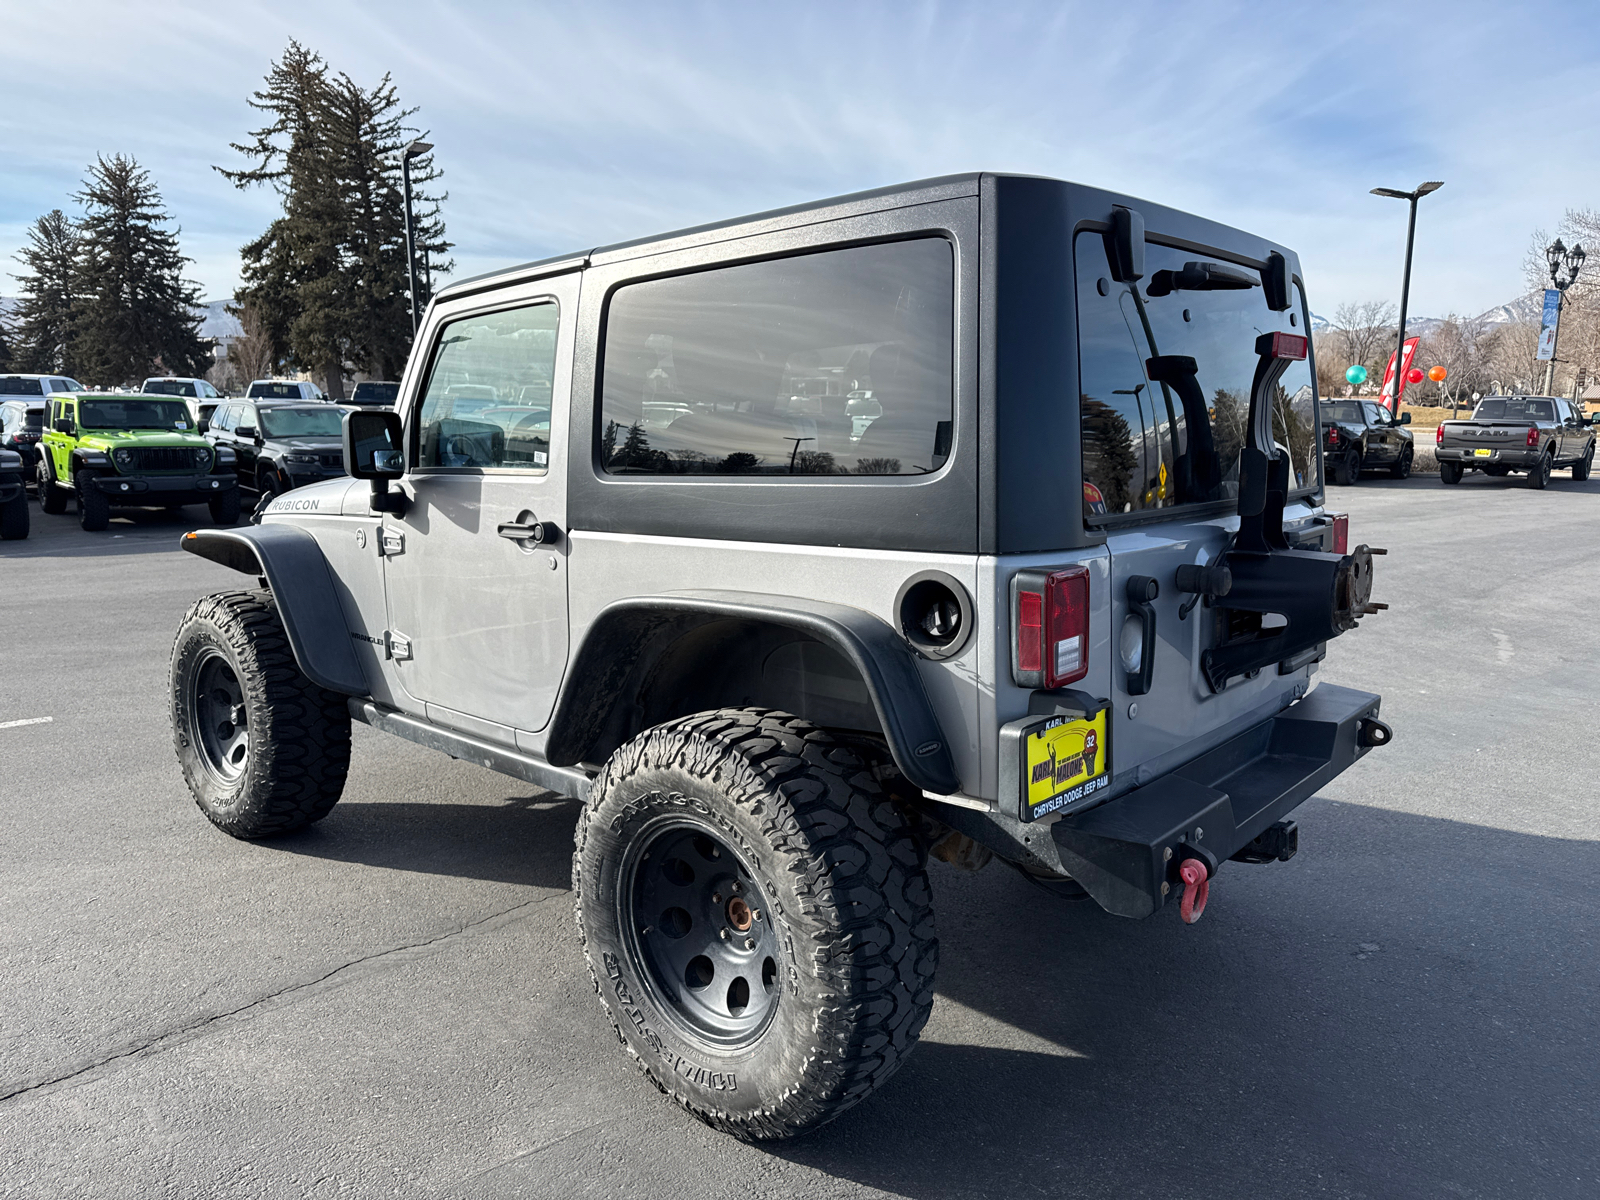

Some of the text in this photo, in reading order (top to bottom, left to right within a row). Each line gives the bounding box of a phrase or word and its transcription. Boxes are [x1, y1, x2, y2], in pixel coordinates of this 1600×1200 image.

[272, 500, 320, 510] RUBICON
[1045, 717, 1063, 730] KARL
[1087, 735, 1095, 748] 32
[1031, 758, 1051, 784] KARL
[1056, 757, 1084, 785] MALONE
[1033, 775, 1108, 819] CHRYSLER DODGE JEEP RAM
[609, 790, 762, 870] PATAGONIA
[603, 951, 738, 1091] MILESTAR
